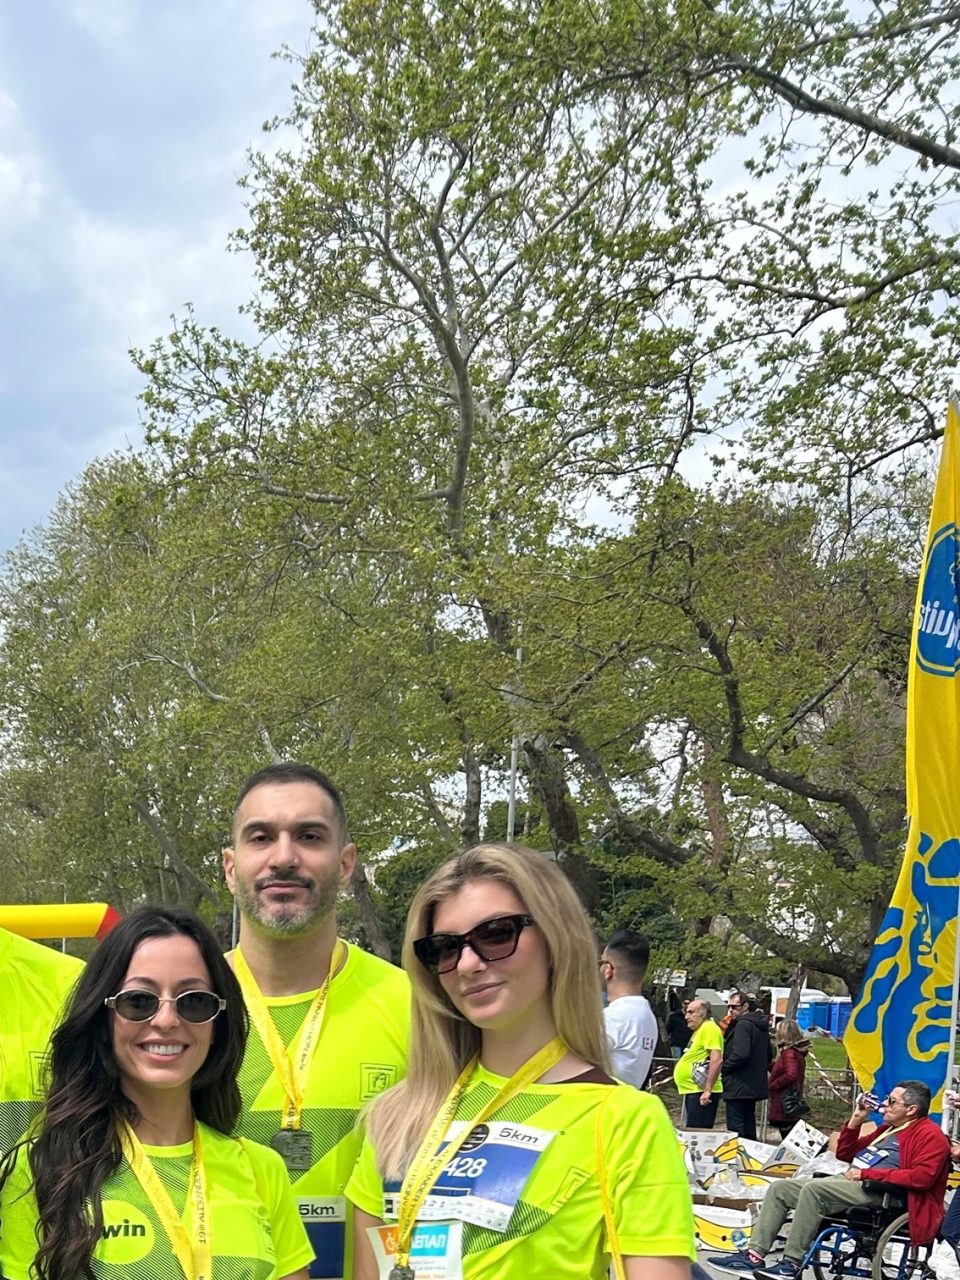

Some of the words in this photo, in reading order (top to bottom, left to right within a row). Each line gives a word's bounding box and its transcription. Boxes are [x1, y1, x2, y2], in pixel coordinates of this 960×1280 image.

[499, 1127, 538, 1144] 5km
[443, 1157, 487, 1178] 428
[299, 1204, 335, 1215] 5km
[102, 1219, 146, 1239] win
